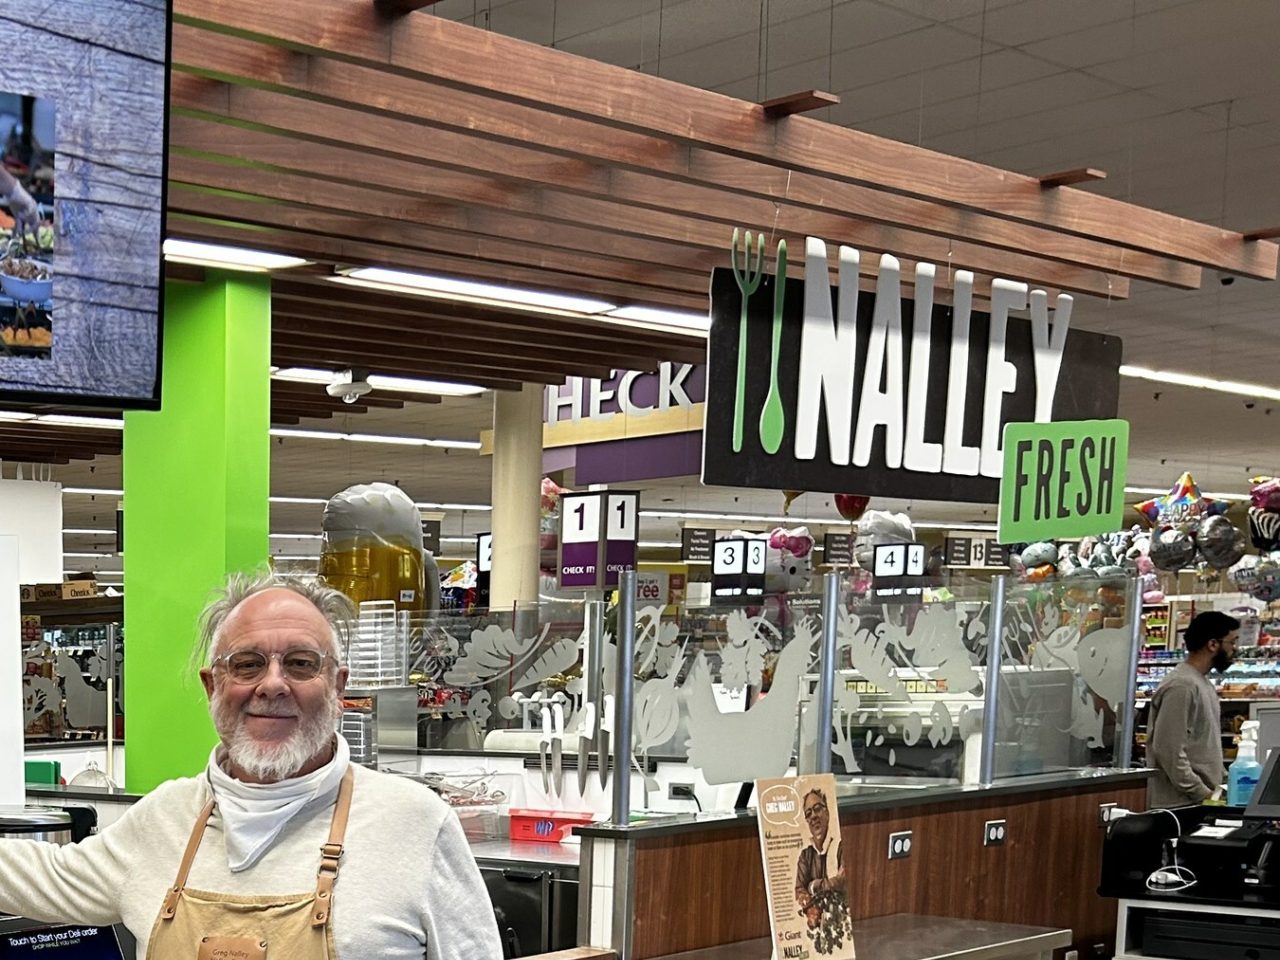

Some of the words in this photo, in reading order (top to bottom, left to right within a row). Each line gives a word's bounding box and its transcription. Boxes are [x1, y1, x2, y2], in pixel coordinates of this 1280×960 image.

[794, 236, 1074, 478] NALLEY
[546, 361, 695, 427] HECK
[1013, 436, 1116, 522] FRESH
[574, 502, 585, 531] 1
[616, 500, 625, 529] 1
[723, 547, 735, 566] 3
[752, 546, 761, 566] 3
[883, 550, 897, 568] 4
[911, 550, 919, 568] 4
[972, 542, 984, 561] 13
[562, 565, 584, 575] CHECK
[586, 565, 596, 574] IT!
[8, 937, 30, 946] Touch
[29, 936, 38, 944] to
[37, 933, 53, 943] Start
[53, 932, 68, 944] your
[68, 929, 81, 938] Deli
[81, 928, 98, 937] order
[212, 948, 228, 957] Greg
[229, 950, 249, 958] Nalley
